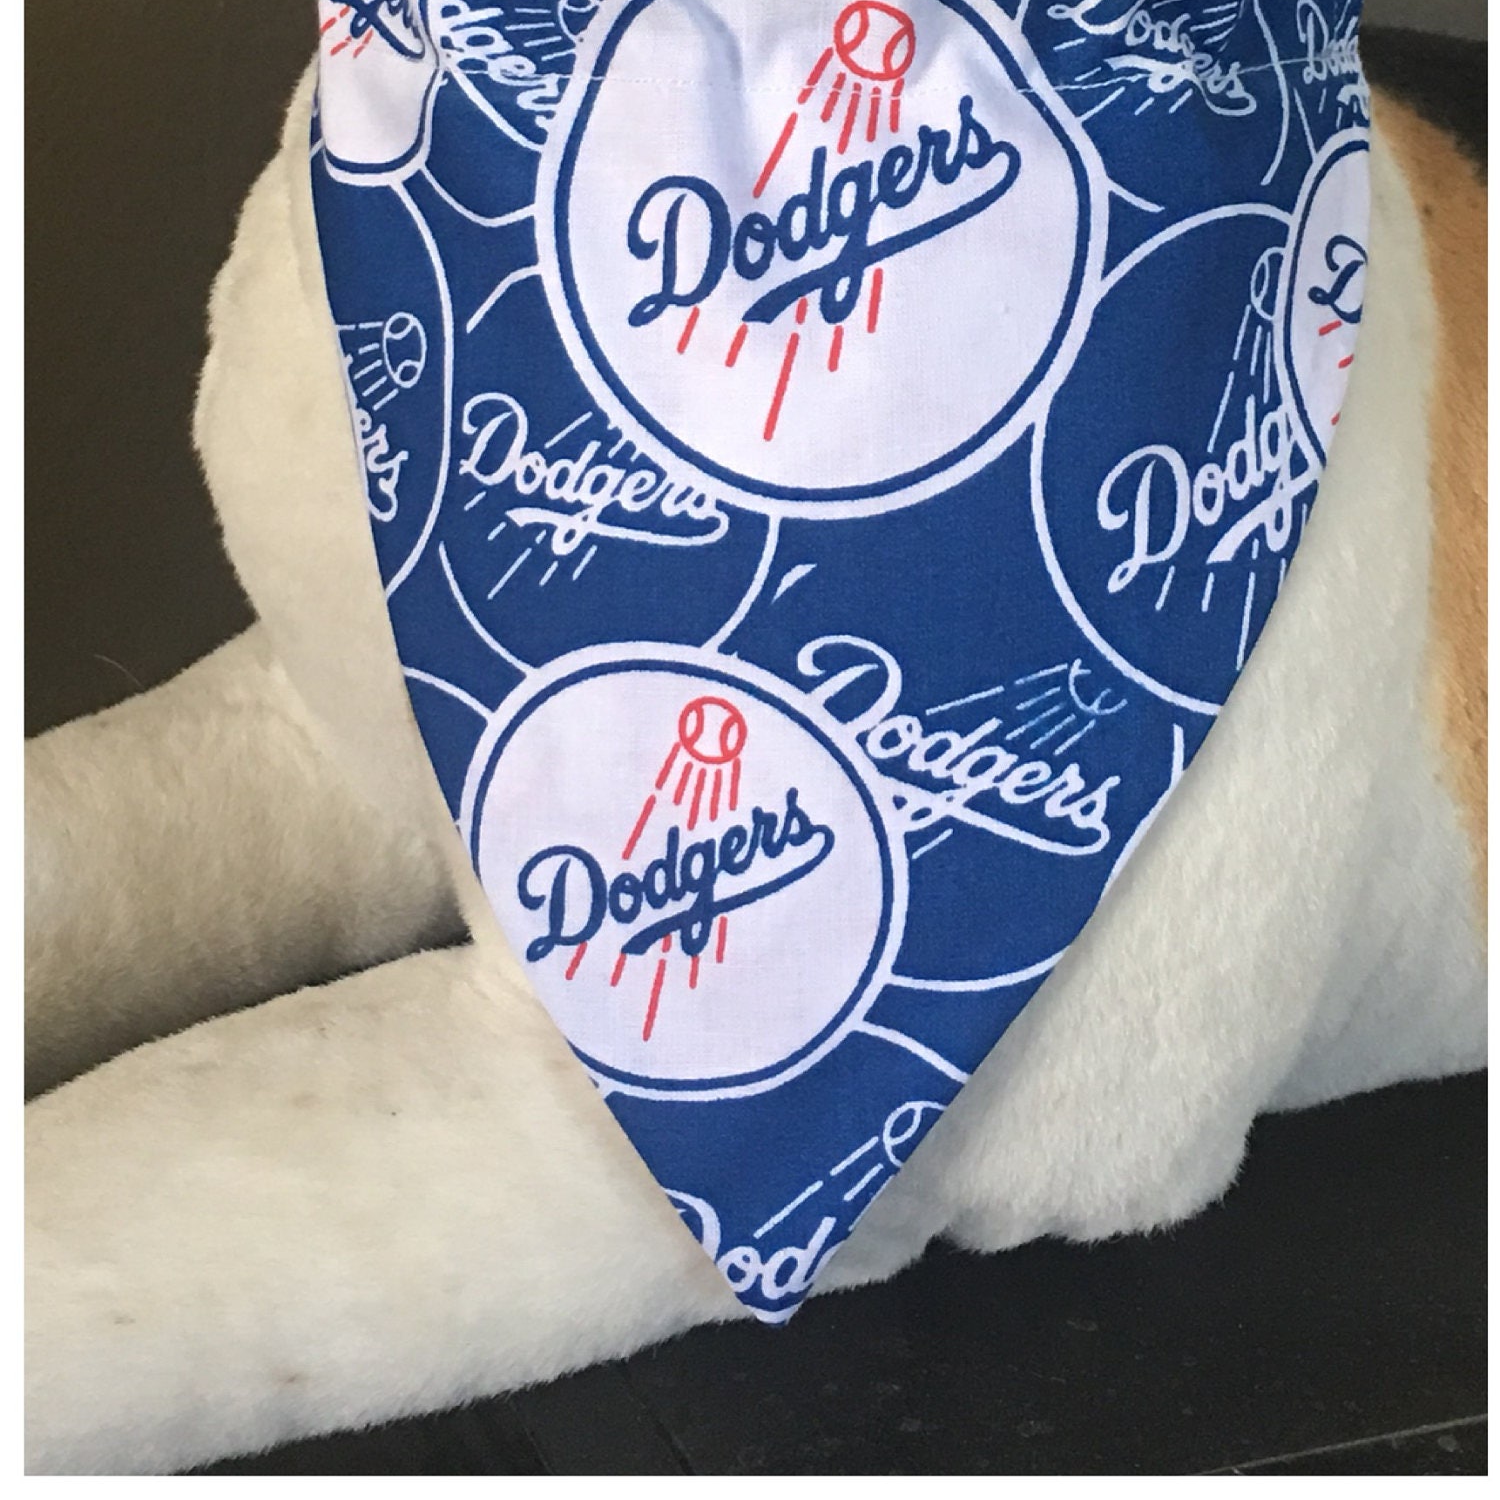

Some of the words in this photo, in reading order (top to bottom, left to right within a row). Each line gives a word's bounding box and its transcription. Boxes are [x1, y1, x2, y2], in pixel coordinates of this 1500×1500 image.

[627, 95, 1021, 327] Dodgers
[458, 392, 730, 555] Dodgers
[1097, 394, 1319, 593] Dodg
[797, 635, 1110, 855] Dodgers
[518, 786, 835, 962] Dodgers
